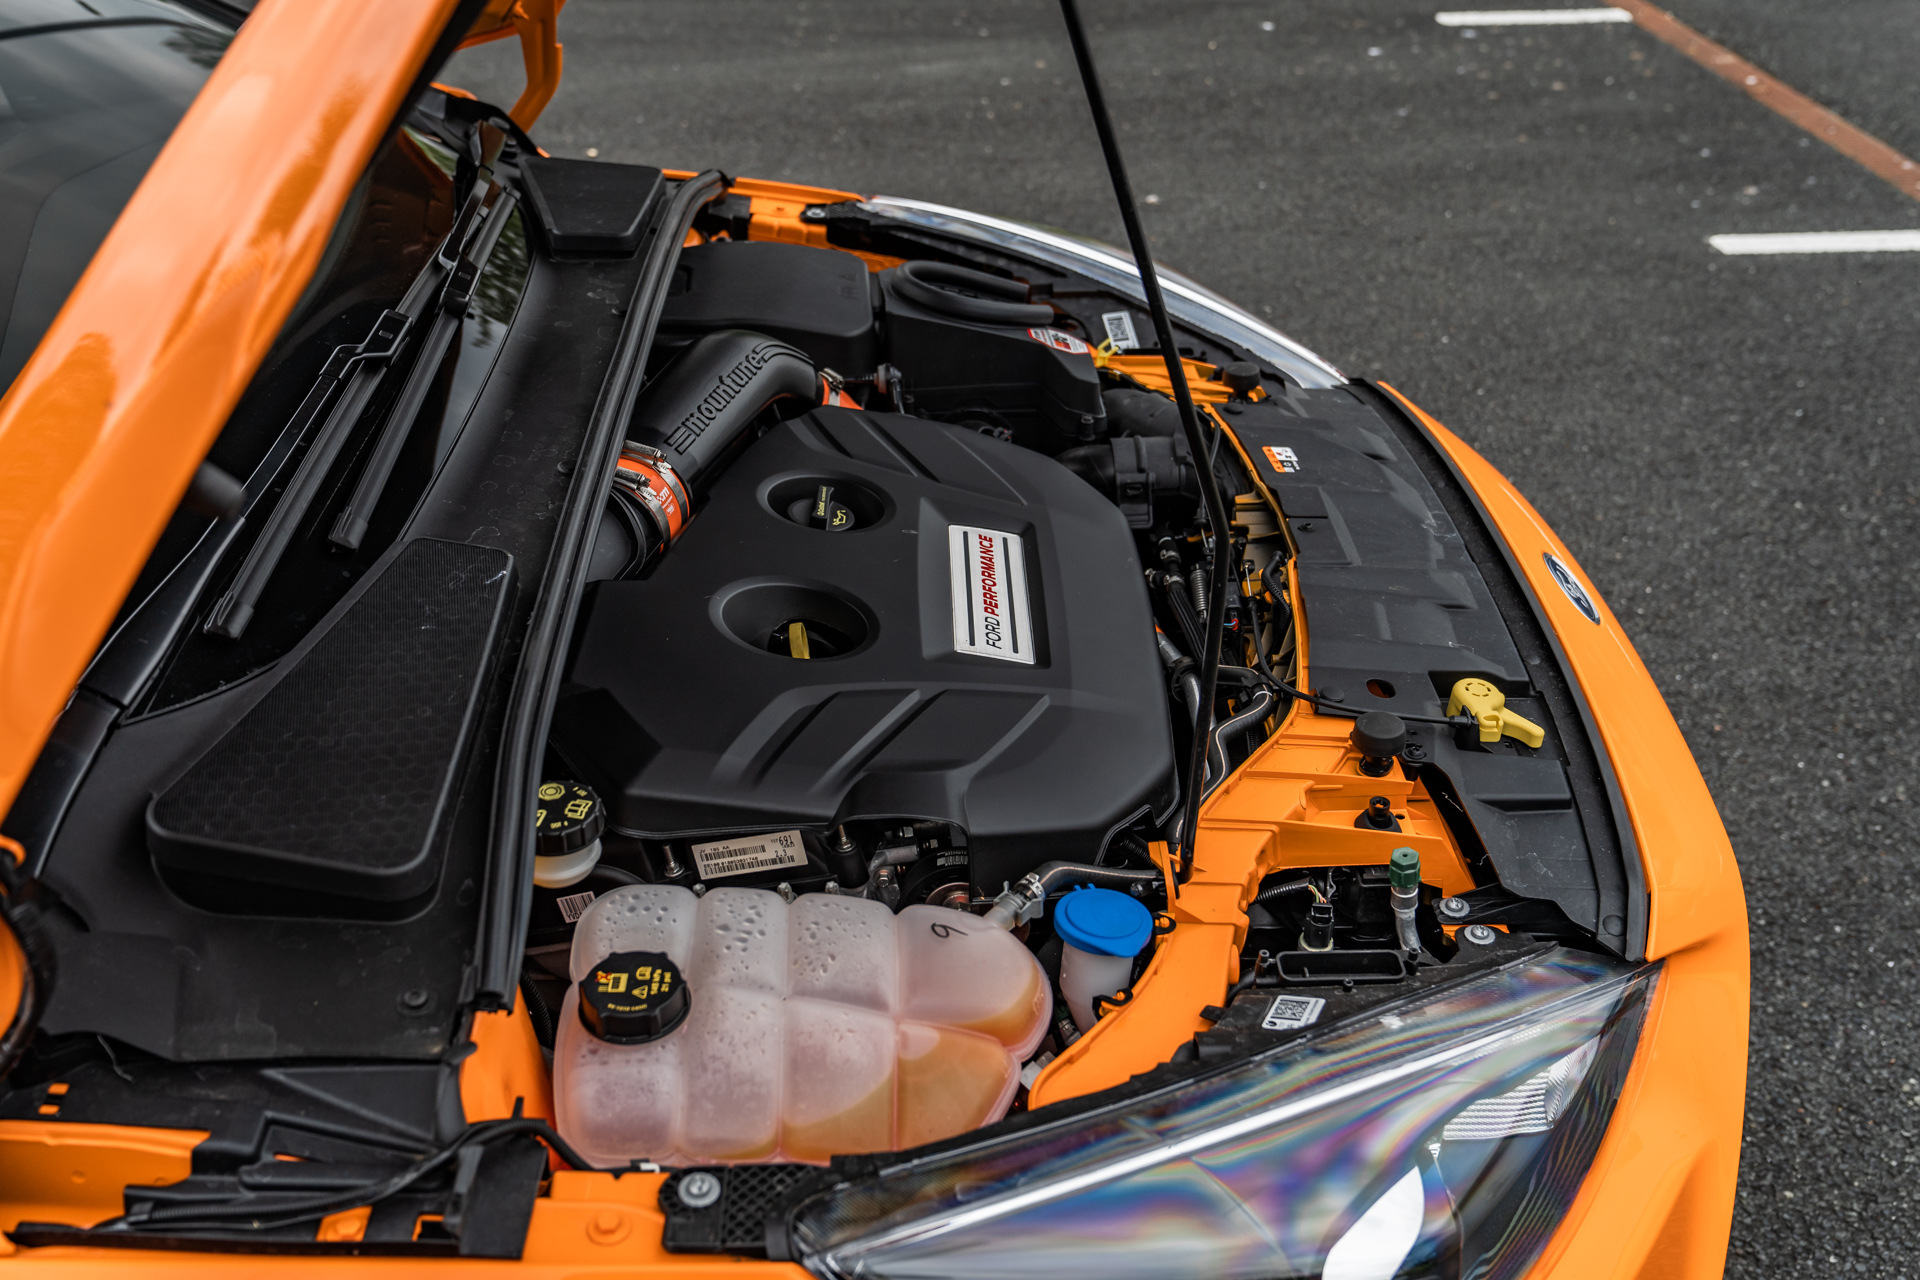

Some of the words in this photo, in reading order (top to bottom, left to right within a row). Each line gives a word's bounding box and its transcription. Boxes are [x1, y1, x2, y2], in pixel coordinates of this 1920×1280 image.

[680, 351, 767, 438] mountune
[978, 533, 1000, 617] PERFORMANCE
[985, 616, 1003, 650] FORD
[779, 835, 793, 845] 691
